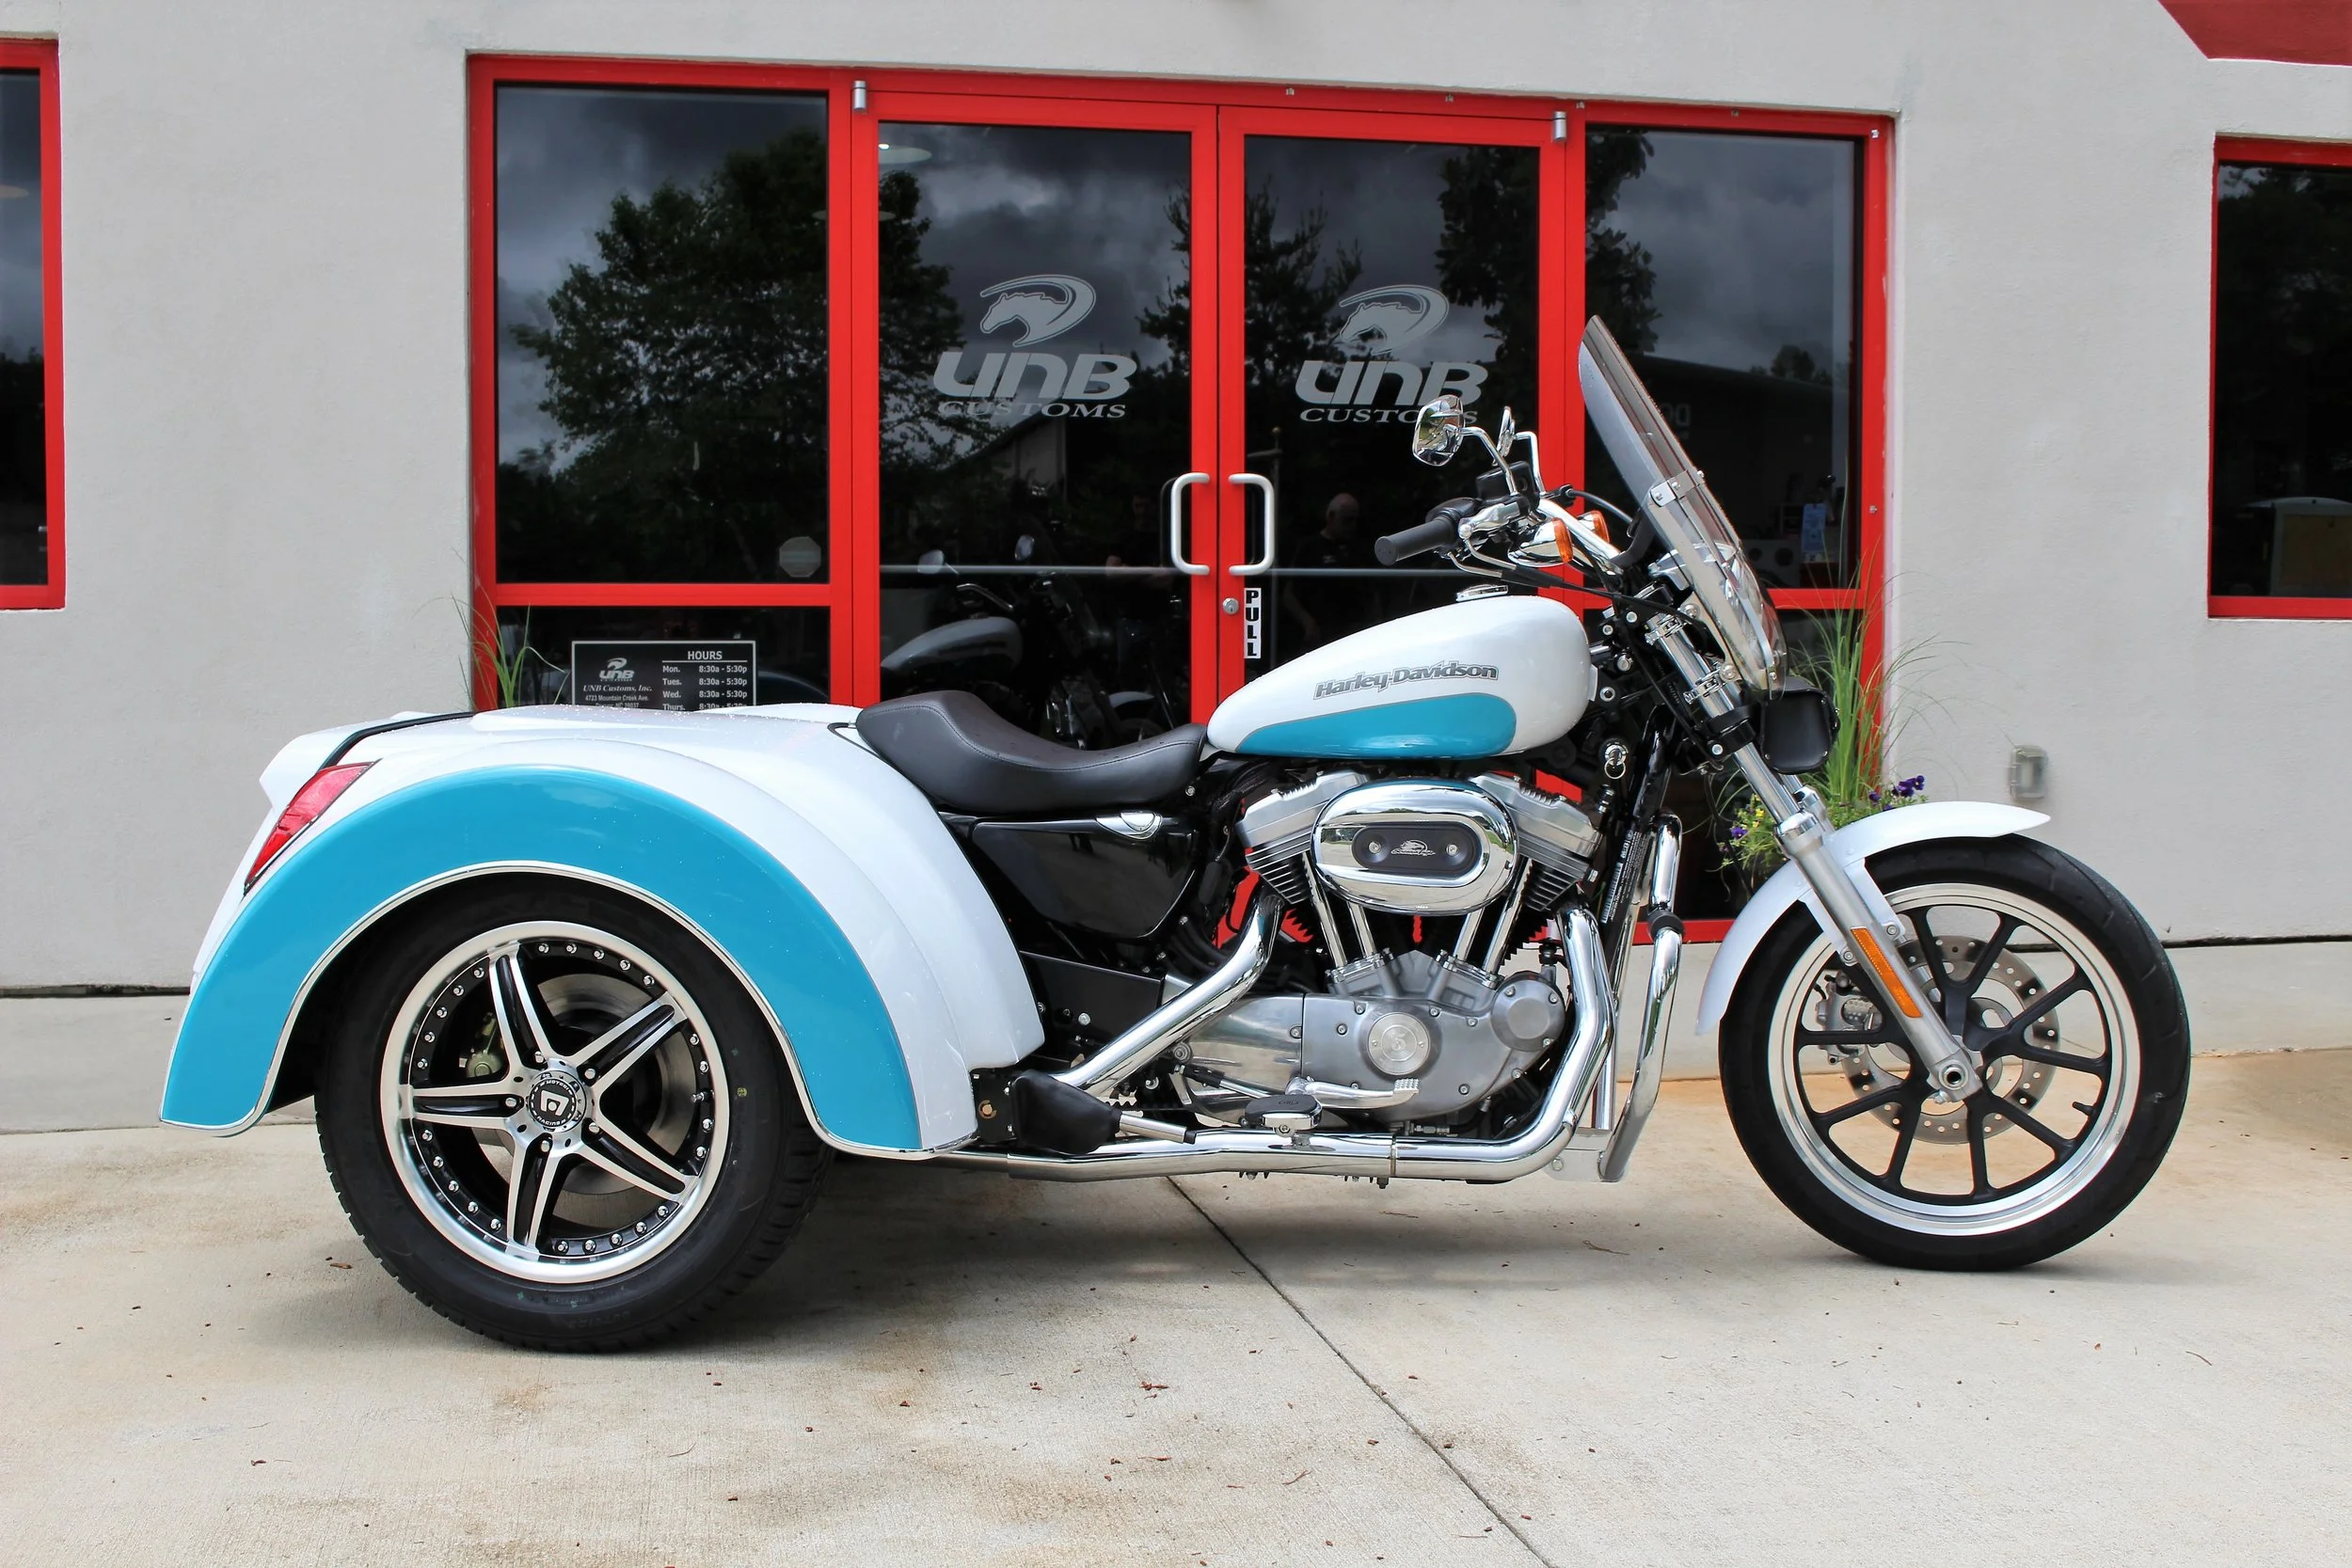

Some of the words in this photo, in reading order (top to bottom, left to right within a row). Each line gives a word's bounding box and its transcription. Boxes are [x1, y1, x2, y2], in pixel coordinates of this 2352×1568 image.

[938, 401, 1126, 418] CUSTOMS
[1299, 408, 1478, 423] CUSTOS
[1246, 590, 1259, 657] PULL
[688, 651, 723, 660] HOURS
[726, 665, 748, 674] 5:30p
[698, 677, 720, 686] 8:30a
[726, 677, 748, 687] 5:30p
[1314, 661, 1499, 699] Harley-Davidson
[726, 690, 748, 699] 5:30p
[536, 1116, 561, 1126] RACING
